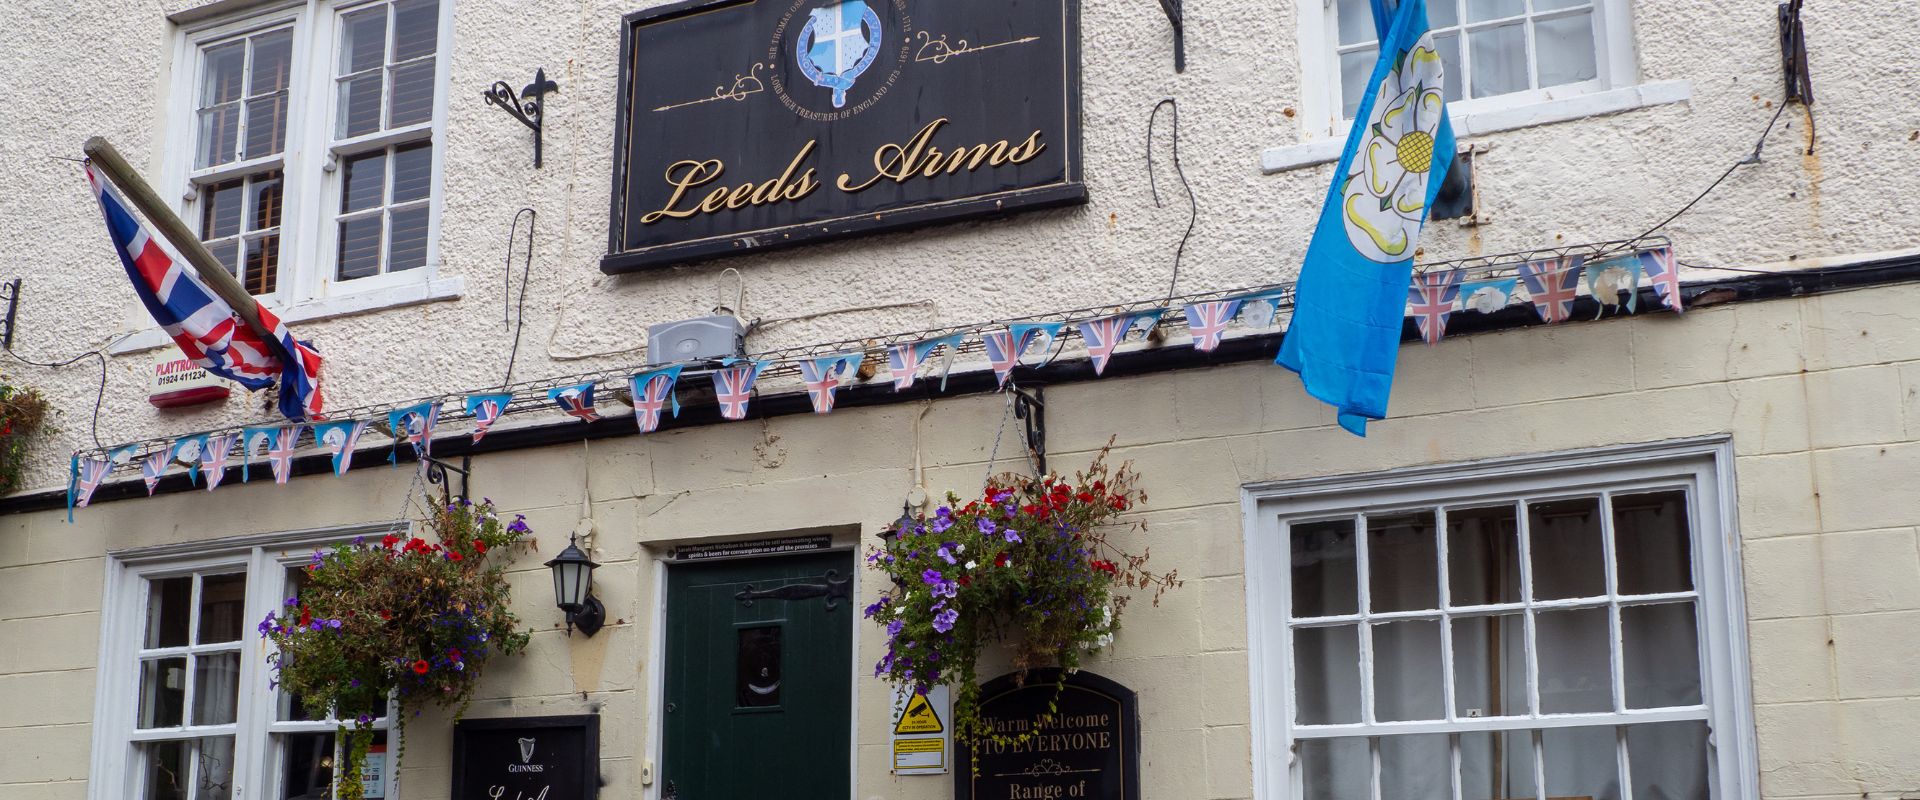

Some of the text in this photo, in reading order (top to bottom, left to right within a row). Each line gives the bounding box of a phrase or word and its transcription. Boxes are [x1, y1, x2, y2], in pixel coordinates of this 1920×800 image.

[772, 11, 793, 45] THOMAS
[769, 46, 778, 60] SIR
[770, 74, 784, 95] LORD
[779, 92, 797, 111] HIGH
[795, 106, 839, 121] TREASURER
[840, 110, 851, 119] OF
[852, 86, 888, 115] ENGLAND
[640, 118, 1046, 226] Leeds Arms
[155, 359, 201, 376] PLAYTRON
[158, 370, 206, 385] 01924 411234
[730, 547, 762, 555] consumption
[794, 543, 818, 551] premises
[983, 712, 1109, 732] Warm Welcome
[983, 732, 1110, 754] TO EVERYONE
[508, 764, 544, 773] GUINNESS
[1010, 780, 1086, 800] Range of
